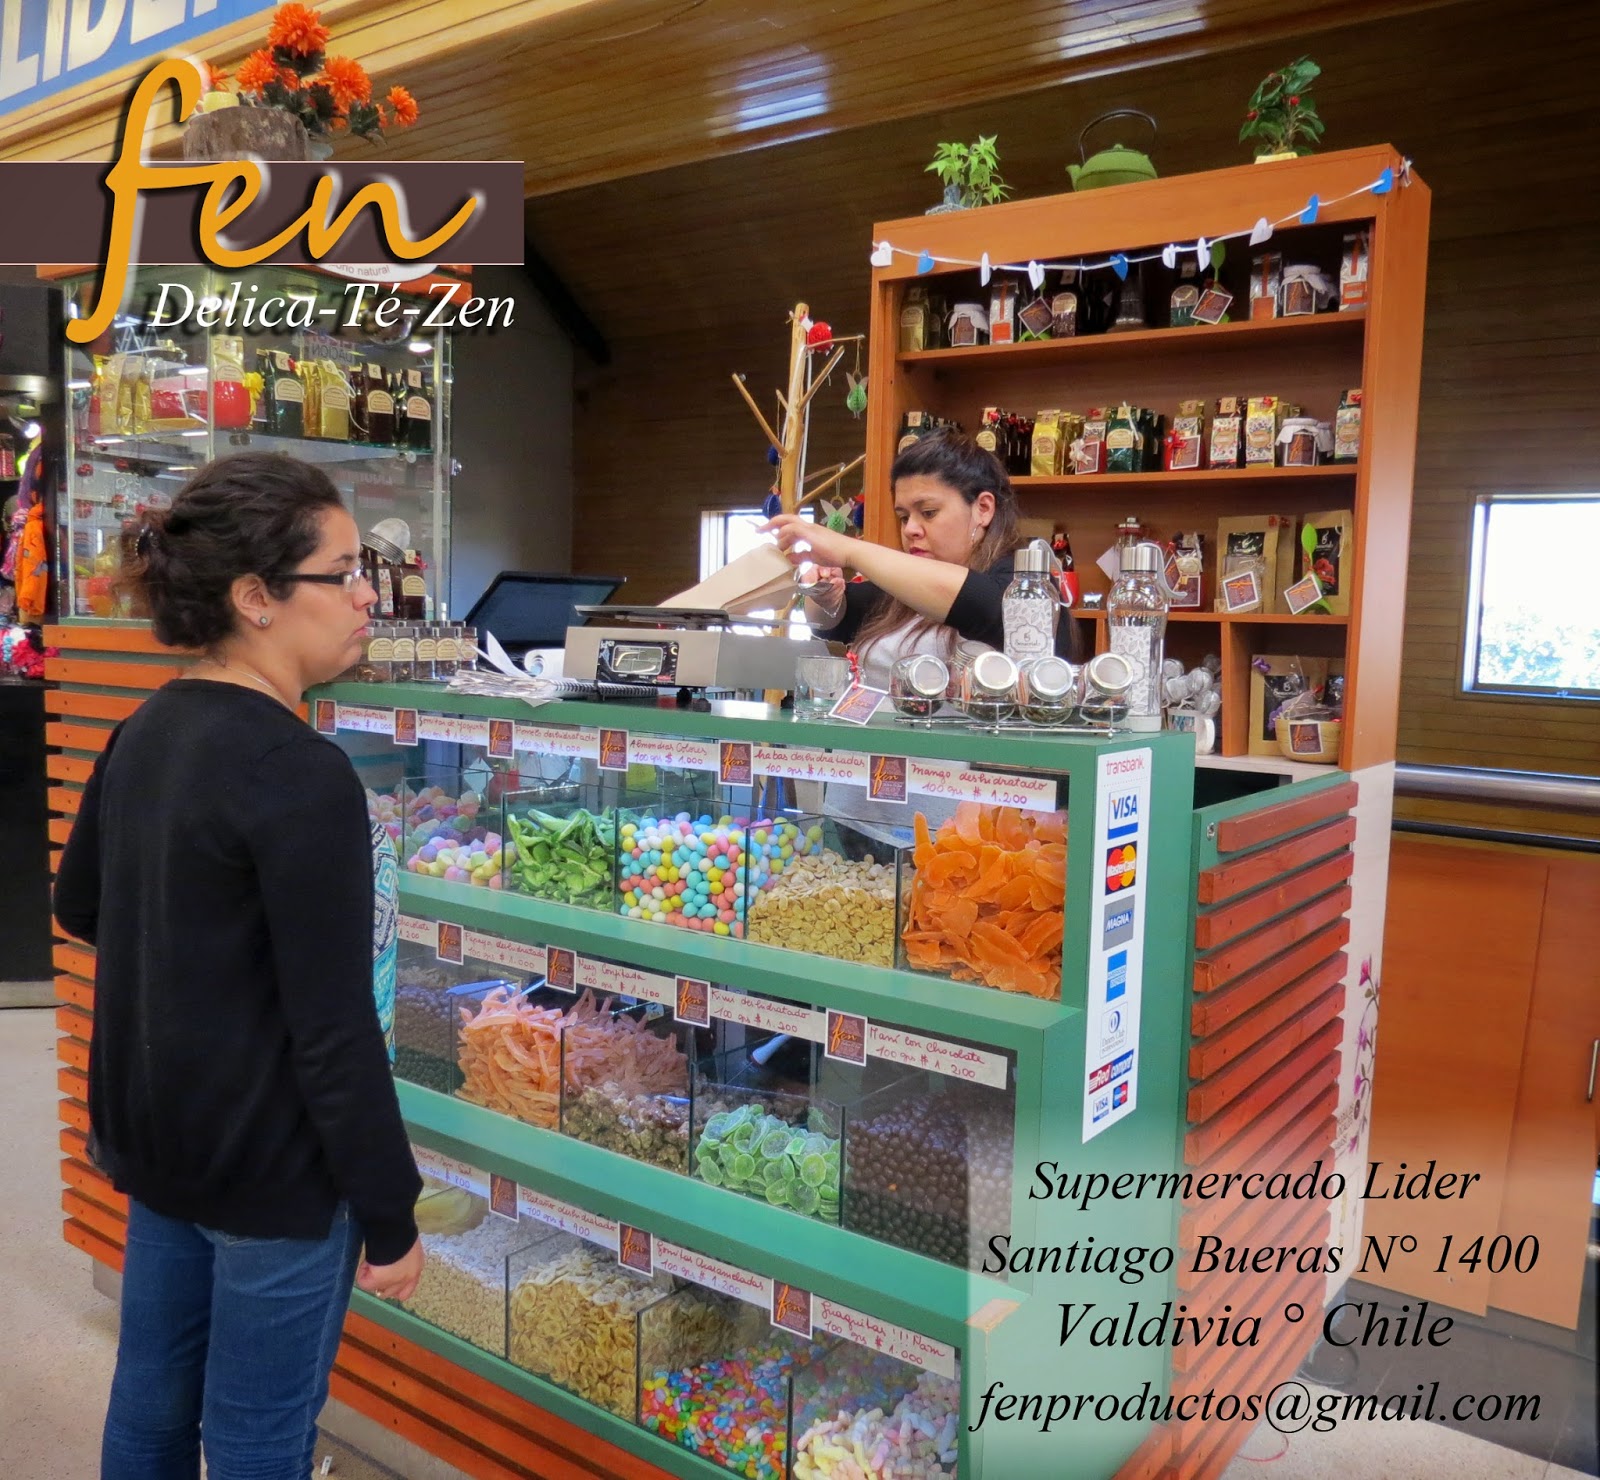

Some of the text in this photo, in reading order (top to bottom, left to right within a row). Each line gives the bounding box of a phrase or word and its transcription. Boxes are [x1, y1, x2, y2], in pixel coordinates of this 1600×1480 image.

[357, 265, 391, 277] natural
[723, 743, 745, 780] fen
[873, 756, 900, 795] fen
[1106, 756, 1144, 776] transbank
[959, 772, 1047, 791] deshidratado
[1112, 794, 1137, 820] VISA
[1105, 911, 1131, 932] MAGNA
[679, 981, 702, 1016] fen
[831, 1015, 858, 1052] fen
[777, 1285, 803, 1321] fen
